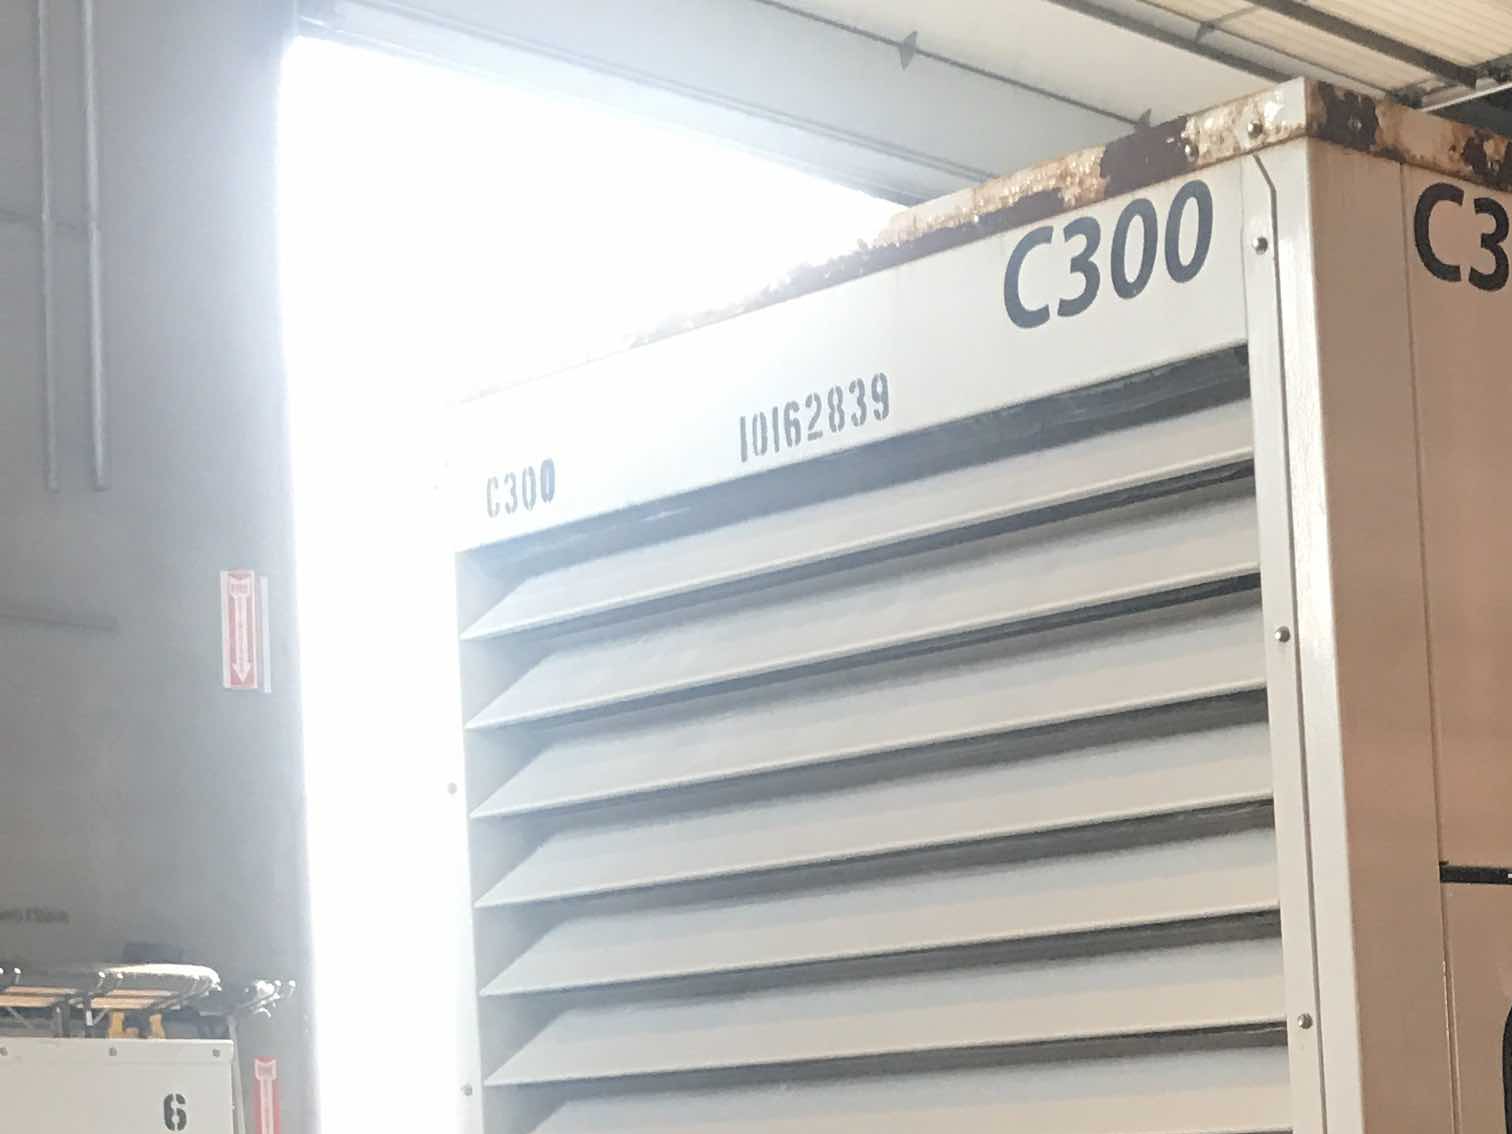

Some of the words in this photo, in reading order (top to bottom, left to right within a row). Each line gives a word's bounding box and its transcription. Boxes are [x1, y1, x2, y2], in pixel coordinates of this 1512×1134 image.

[1003, 178, 1213, 329] C300
[739, 372, 891, 462] 10162839
[486, 458, 556, 518] C300
[163, 1093, 187, 1131] 6
